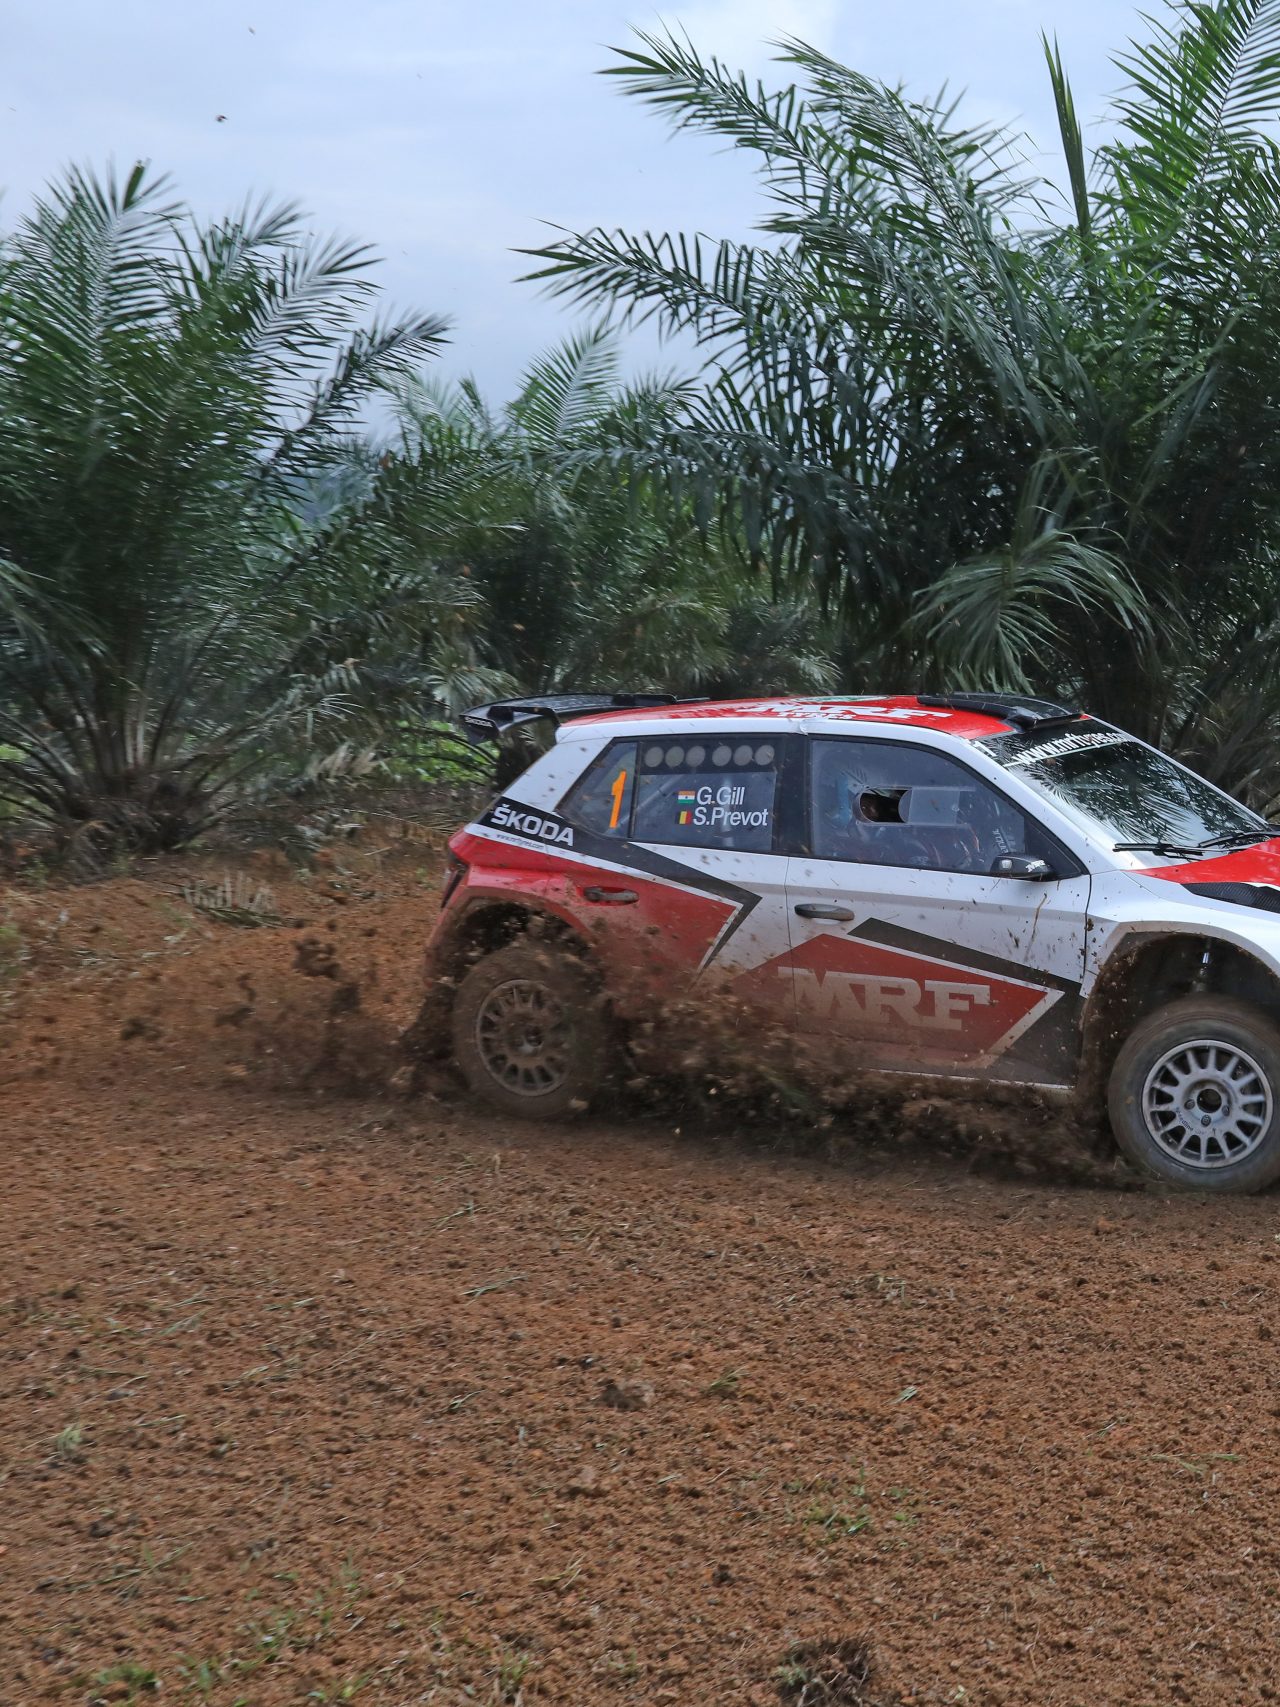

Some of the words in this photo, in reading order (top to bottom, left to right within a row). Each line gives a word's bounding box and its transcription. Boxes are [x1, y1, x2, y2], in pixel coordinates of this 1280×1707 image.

[735, 703, 953, 719] MRF
[609, 769, 627, 829] 1
[696, 786, 746, 806] G.Gill
[491, 803, 574, 847] ŠKODA
[693, 806, 769, 827] S.Prevot
[777, 963, 991, 1031] MRF
